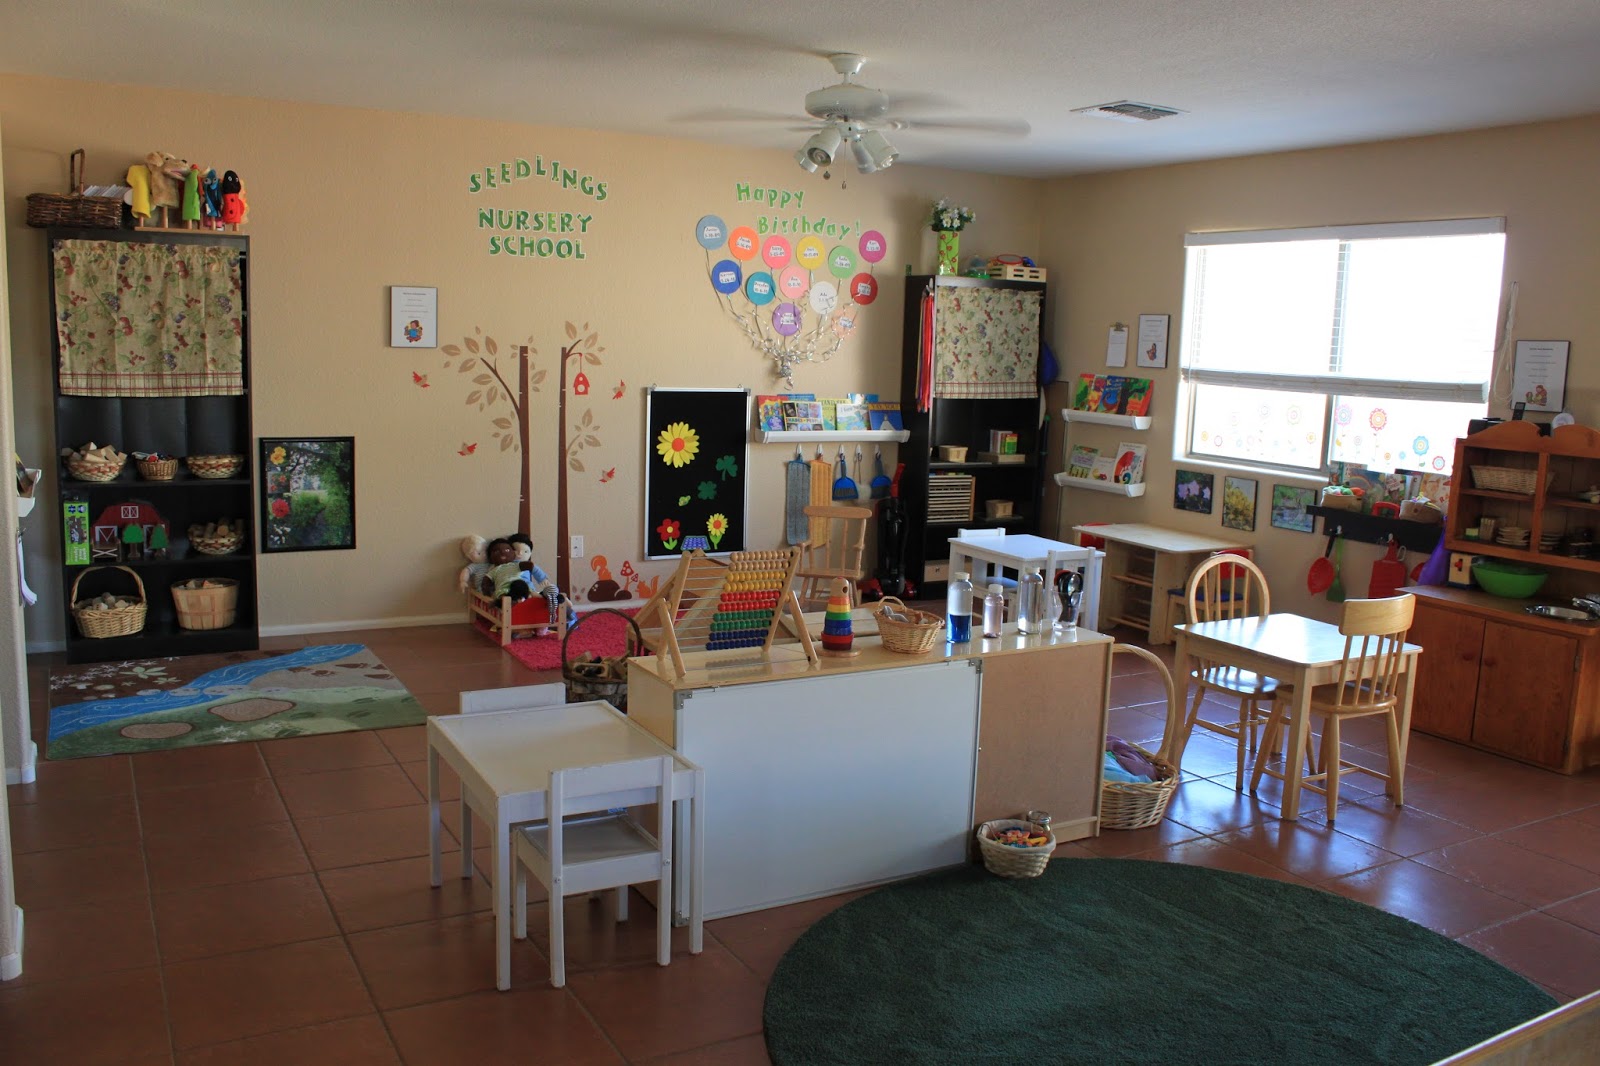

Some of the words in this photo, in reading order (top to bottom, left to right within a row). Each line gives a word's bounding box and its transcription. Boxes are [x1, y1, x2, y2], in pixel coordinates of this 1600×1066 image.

[469, 155, 608, 201] SEEDLINGS
[736, 183, 804, 208] Happy
[478, 207, 593, 233] NURSERY
[757, 215, 861, 240] Birthday!
[489, 235, 586, 260] SCHOOL
